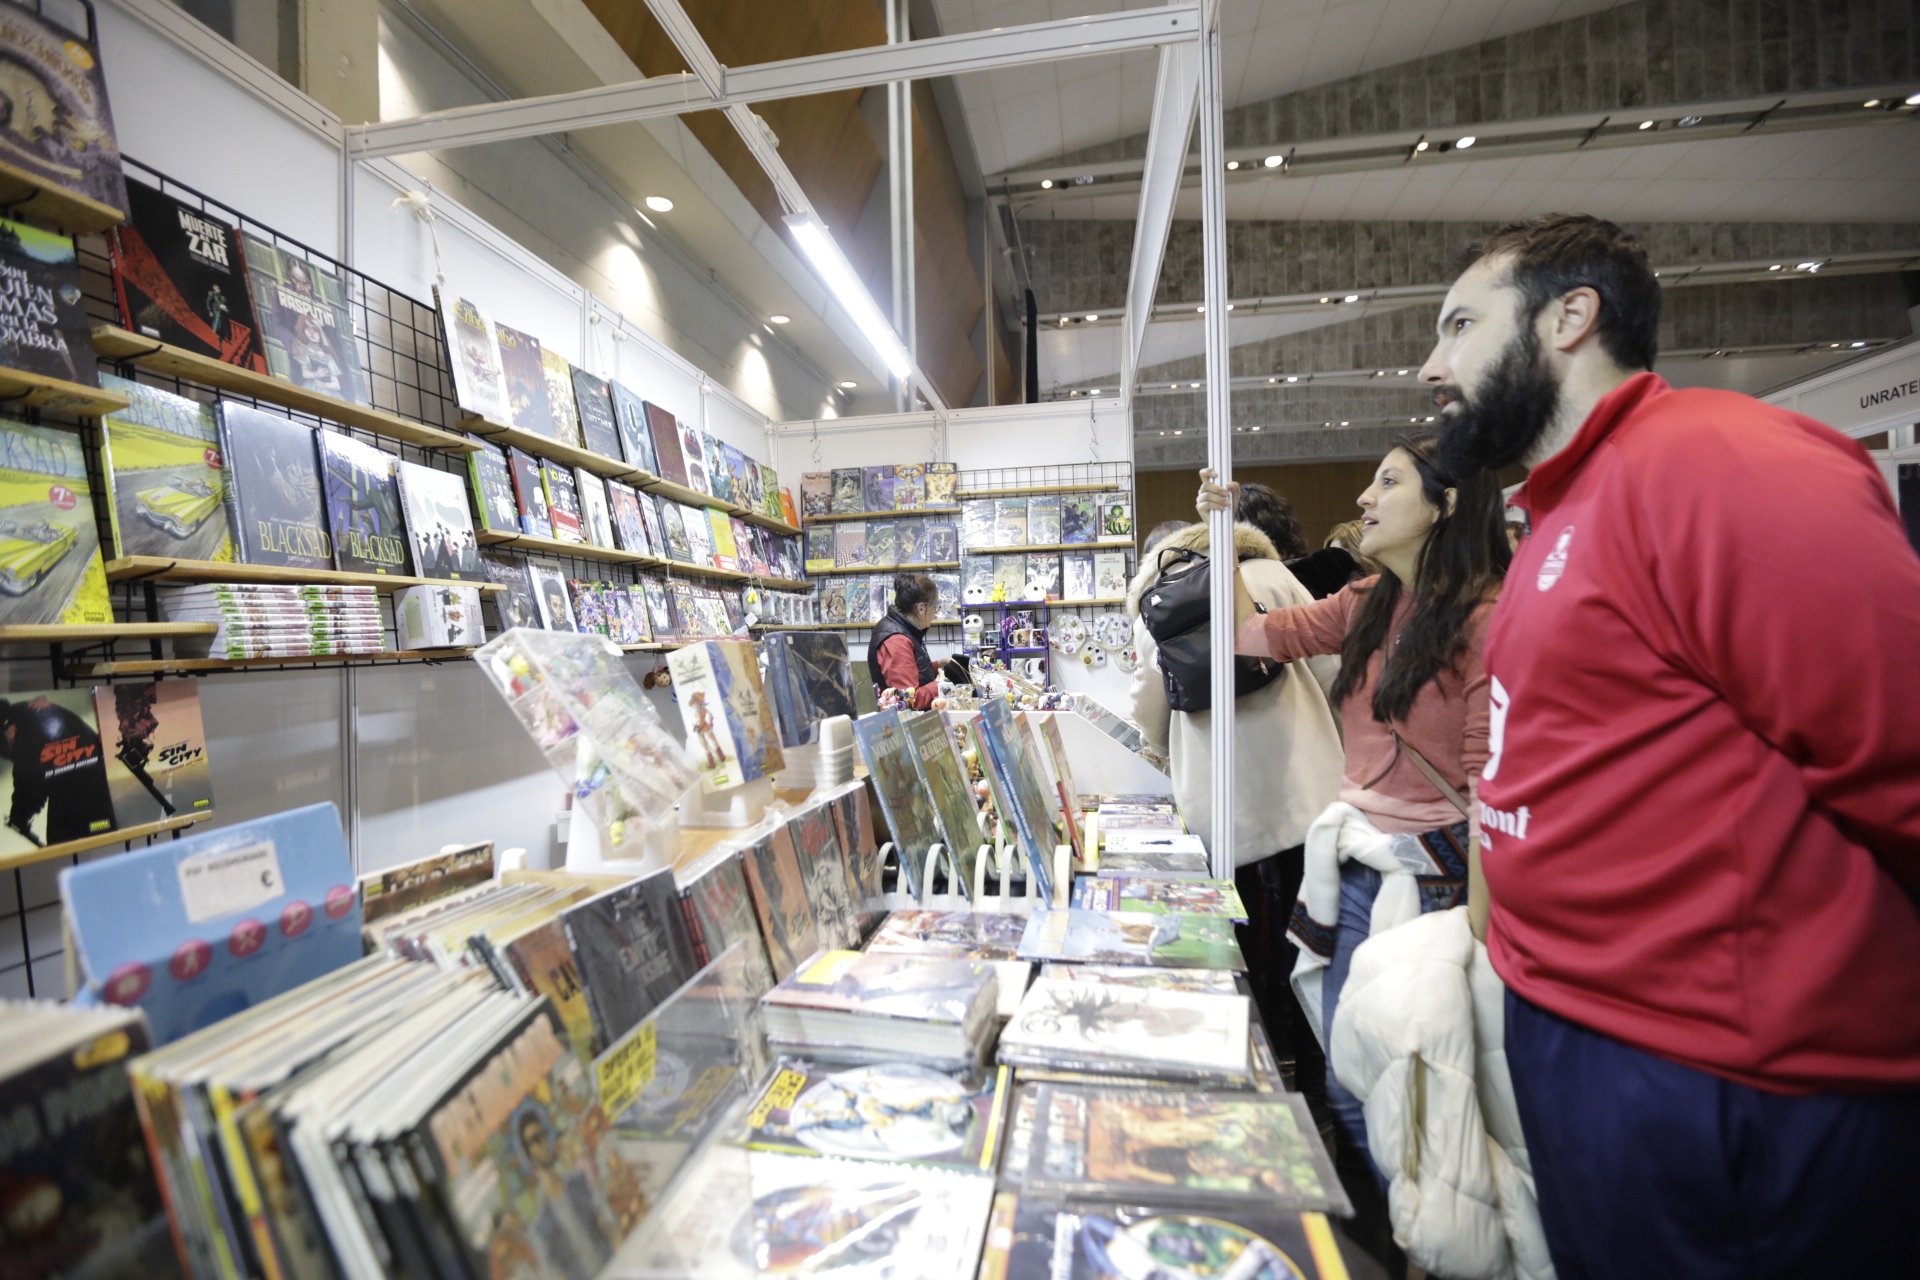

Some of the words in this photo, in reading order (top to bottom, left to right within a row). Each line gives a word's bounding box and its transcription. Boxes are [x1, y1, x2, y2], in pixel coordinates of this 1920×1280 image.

[178, 210, 228, 249] MUERTE
[186, 231, 230, 267] ZAR
[0, 279, 55, 313] UIEN
[0, 294, 58, 325] MAS
[278, 289, 336, 329] RASPUTIN
[0, 325, 70, 355] OMBRA
[1860, 378, 1920, 409] UNRATE
[0, 432, 68, 477] KSAD
[257, 520, 332, 559] BLACKSAD
[349, 531, 405, 564] BLACKSAD
[677, 585, 691, 595] JSA
[727, 591, 739, 600] JSA
[40, 737, 78, 763] SIN
[53, 745, 96, 767] CITY
[158, 744, 188, 762] SIN
[169, 747, 202, 766] CITY
